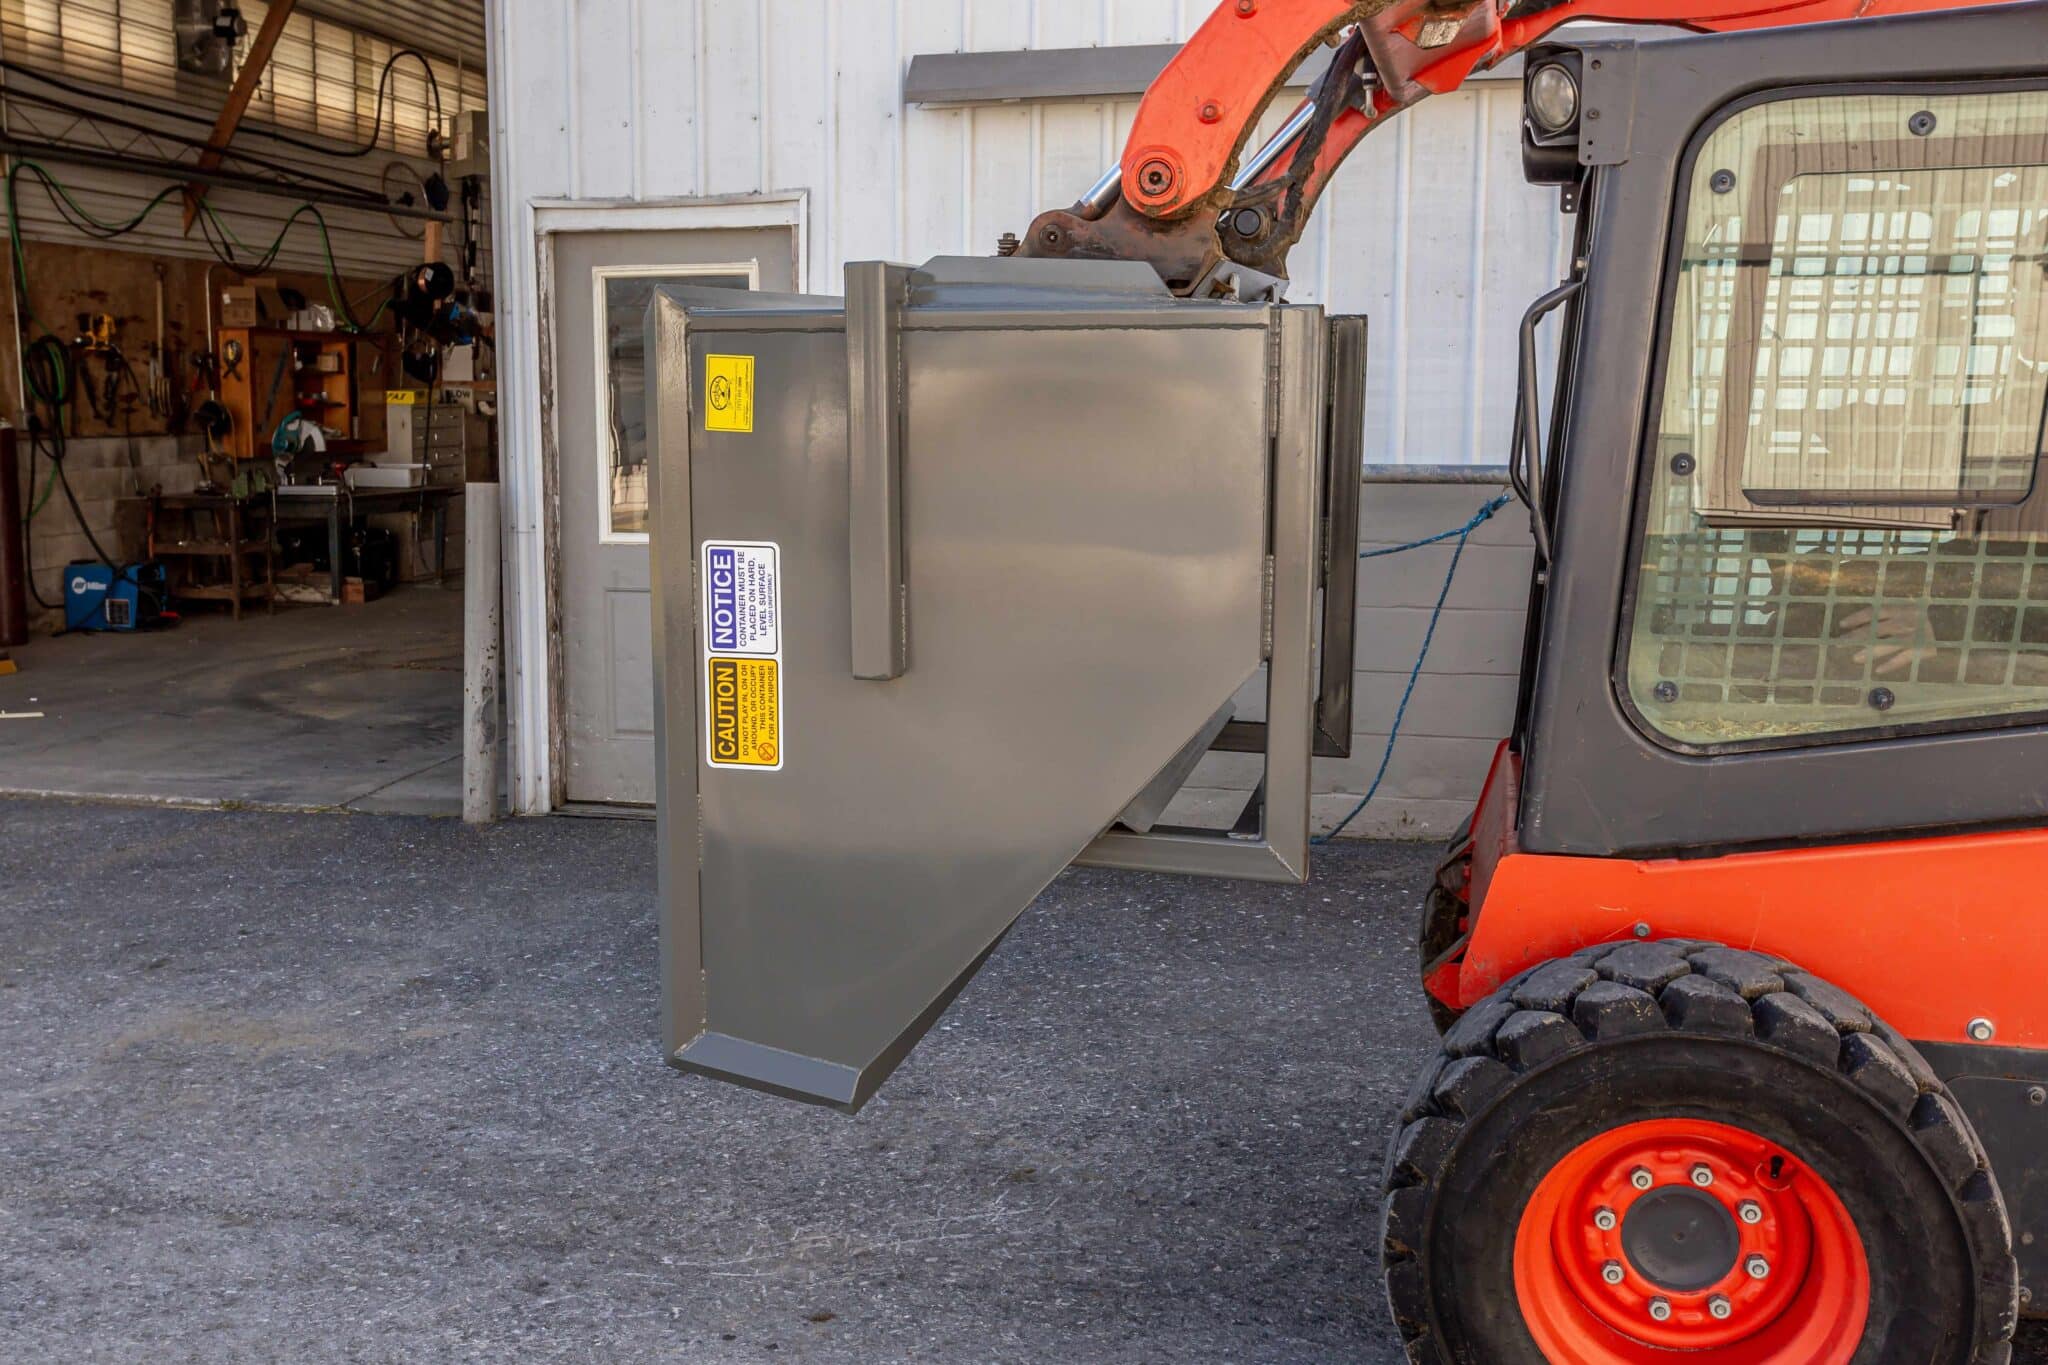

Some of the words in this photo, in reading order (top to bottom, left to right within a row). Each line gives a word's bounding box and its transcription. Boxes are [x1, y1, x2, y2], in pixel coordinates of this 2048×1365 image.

[738, 552, 744, 563] BE
[758, 564, 766, 605] SURFACE
[714, 555, 733, 644] NOTICE
[749, 589, 755, 602] ON
[738, 595, 746, 646] CONTAINER
[742, 665, 747, 676] OR
[742, 679, 747, 690] ON
[717, 668, 735, 756] CAUTION
[751, 701, 757, 712] OR
[743, 745, 749, 756] DO
